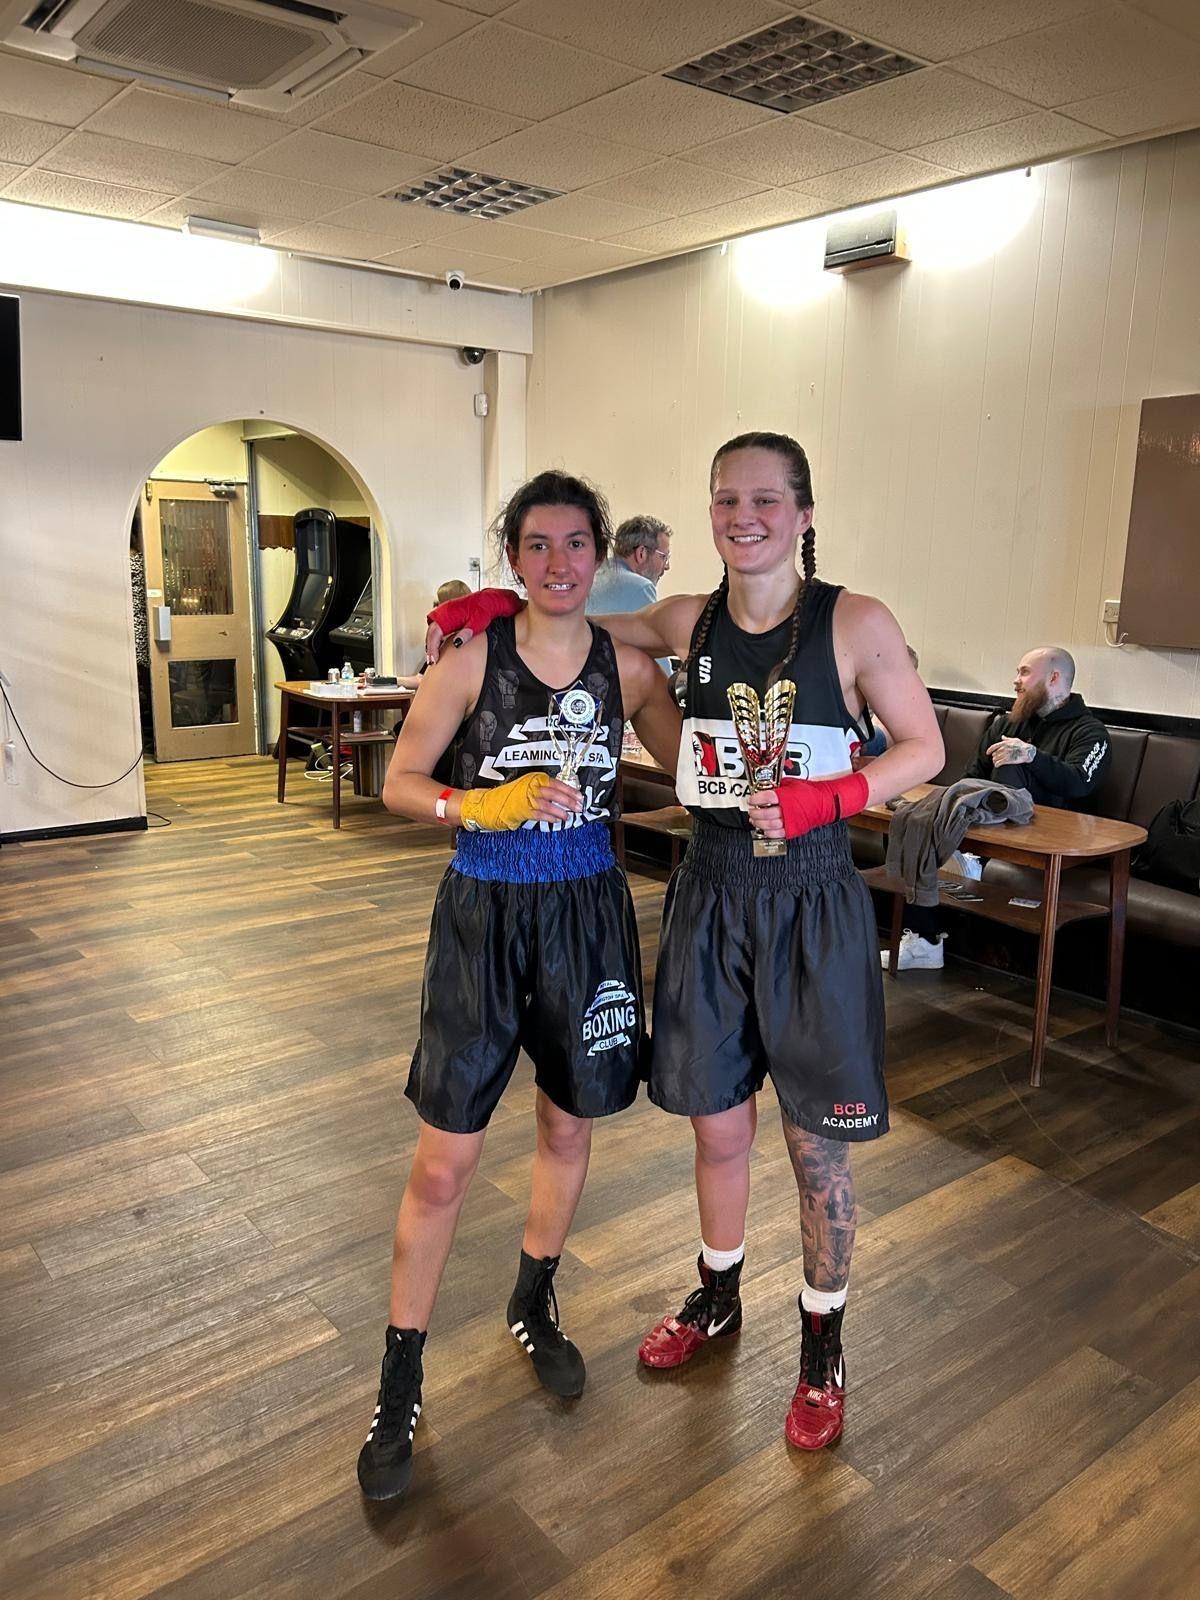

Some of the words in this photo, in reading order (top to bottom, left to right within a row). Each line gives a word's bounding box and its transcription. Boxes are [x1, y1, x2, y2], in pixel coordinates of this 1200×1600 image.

[714, 737, 812, 780] BB
[698, 780, 727, 795] BCB
[582, 1005, 637, 1041] BOXING
[599, 1038, 618, 1050] CLUB
[833, 1102, 867, 1116] BCB
[822, 1113, 879, 1129] ACADEMY
[807, 1389, 822, 1401] NIKE
